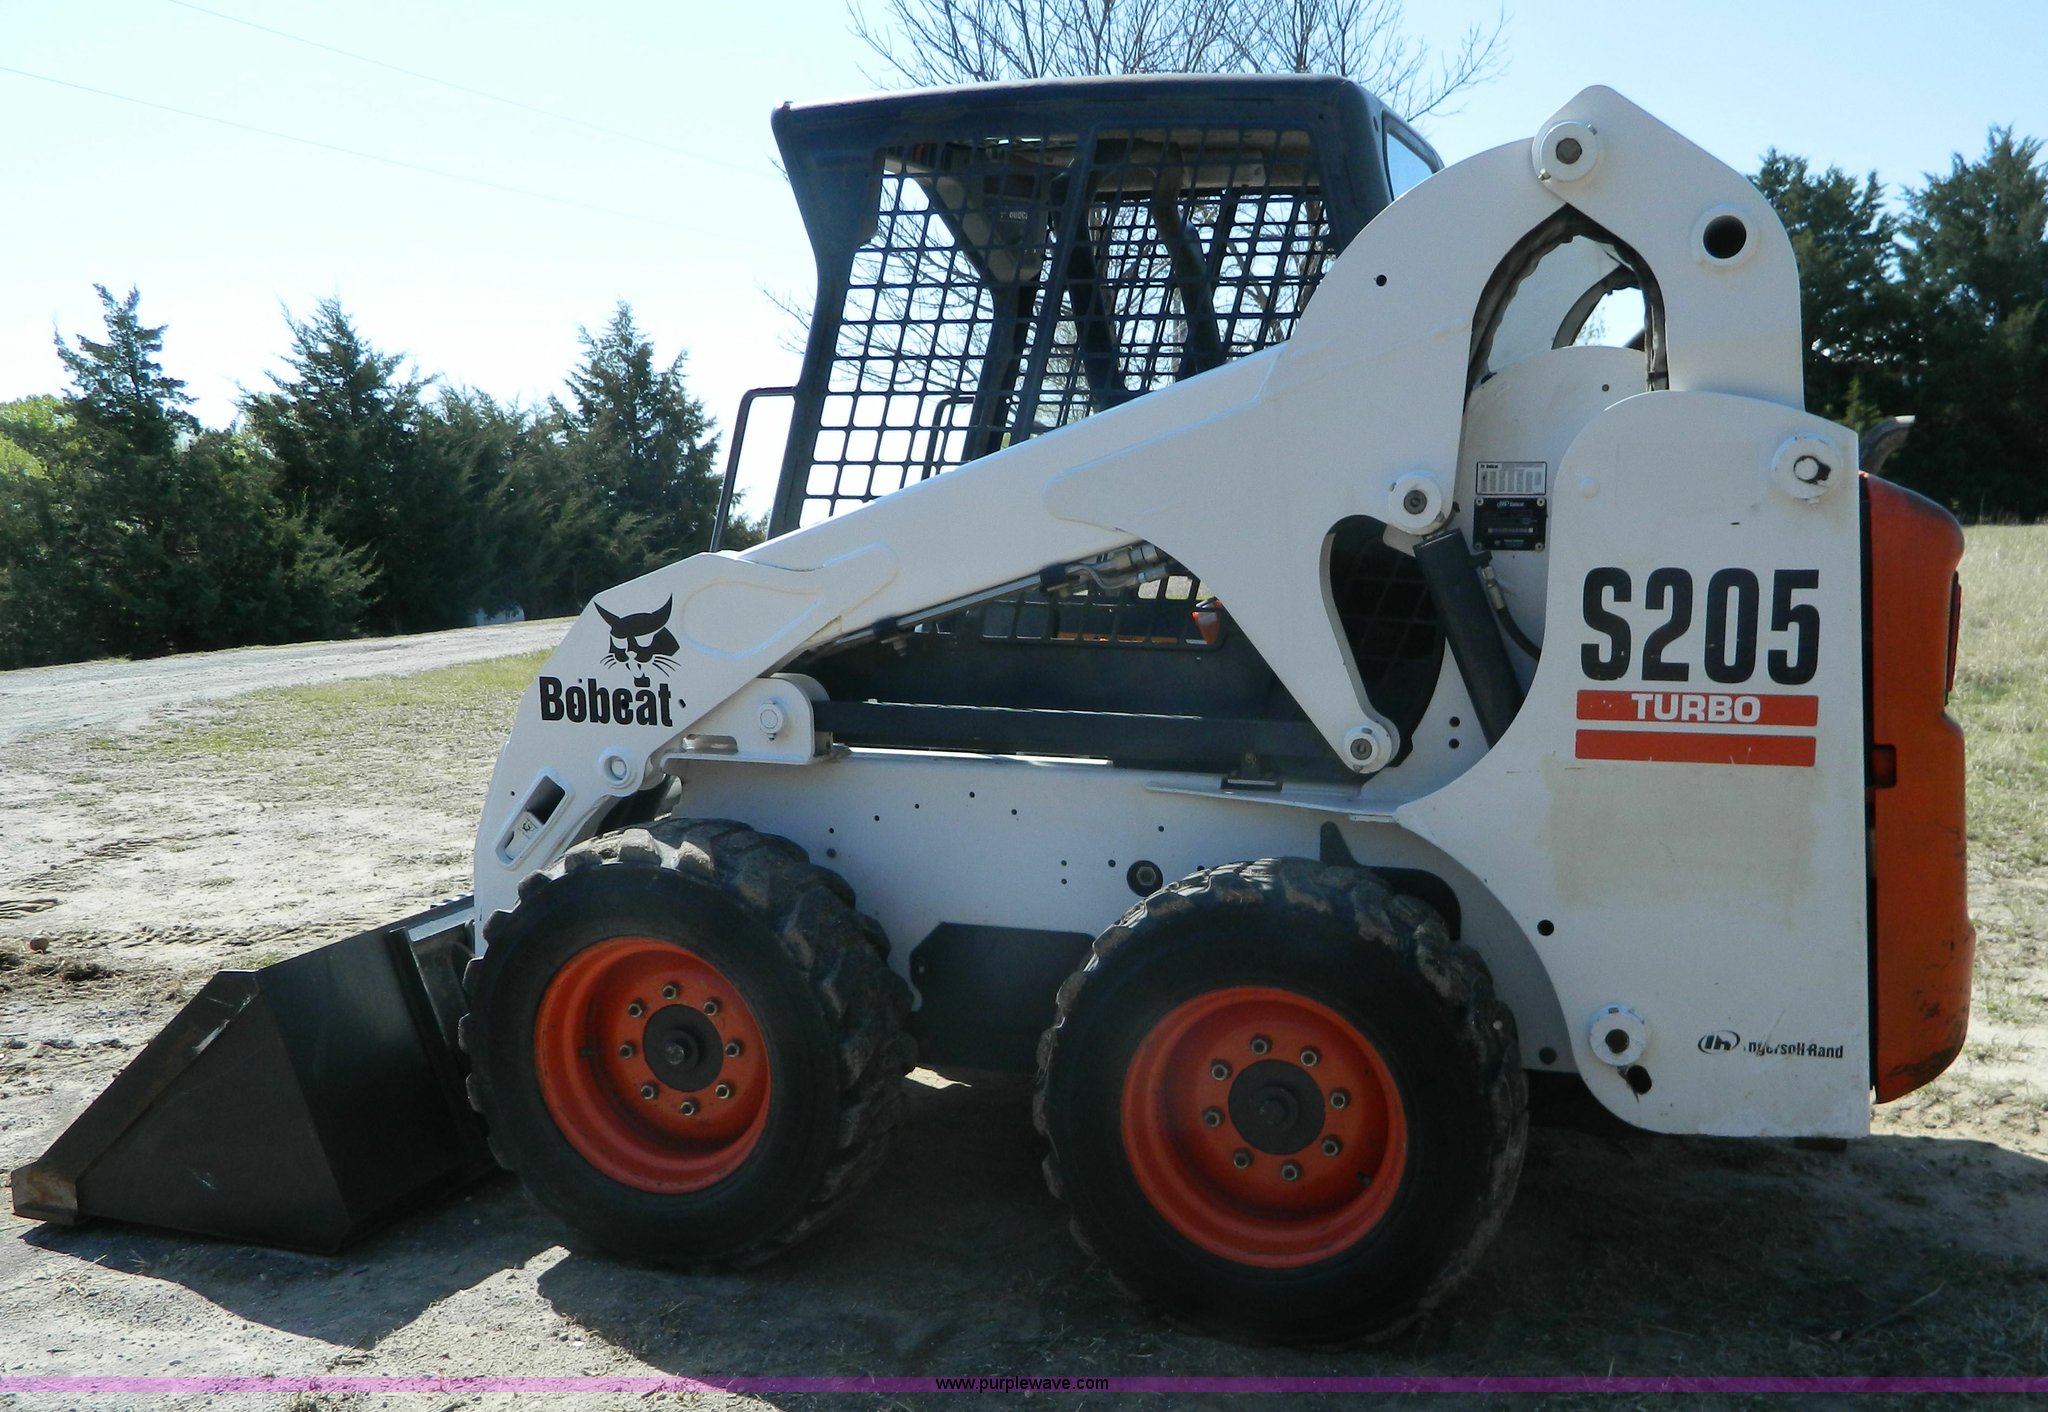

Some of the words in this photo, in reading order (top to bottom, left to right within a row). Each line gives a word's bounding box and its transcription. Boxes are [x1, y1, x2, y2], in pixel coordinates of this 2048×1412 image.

[1580, 566, 1820, 685] S205
[539, 676, 673, 727] Bobcat
[1631, 693, 1761, 722] TURBO
